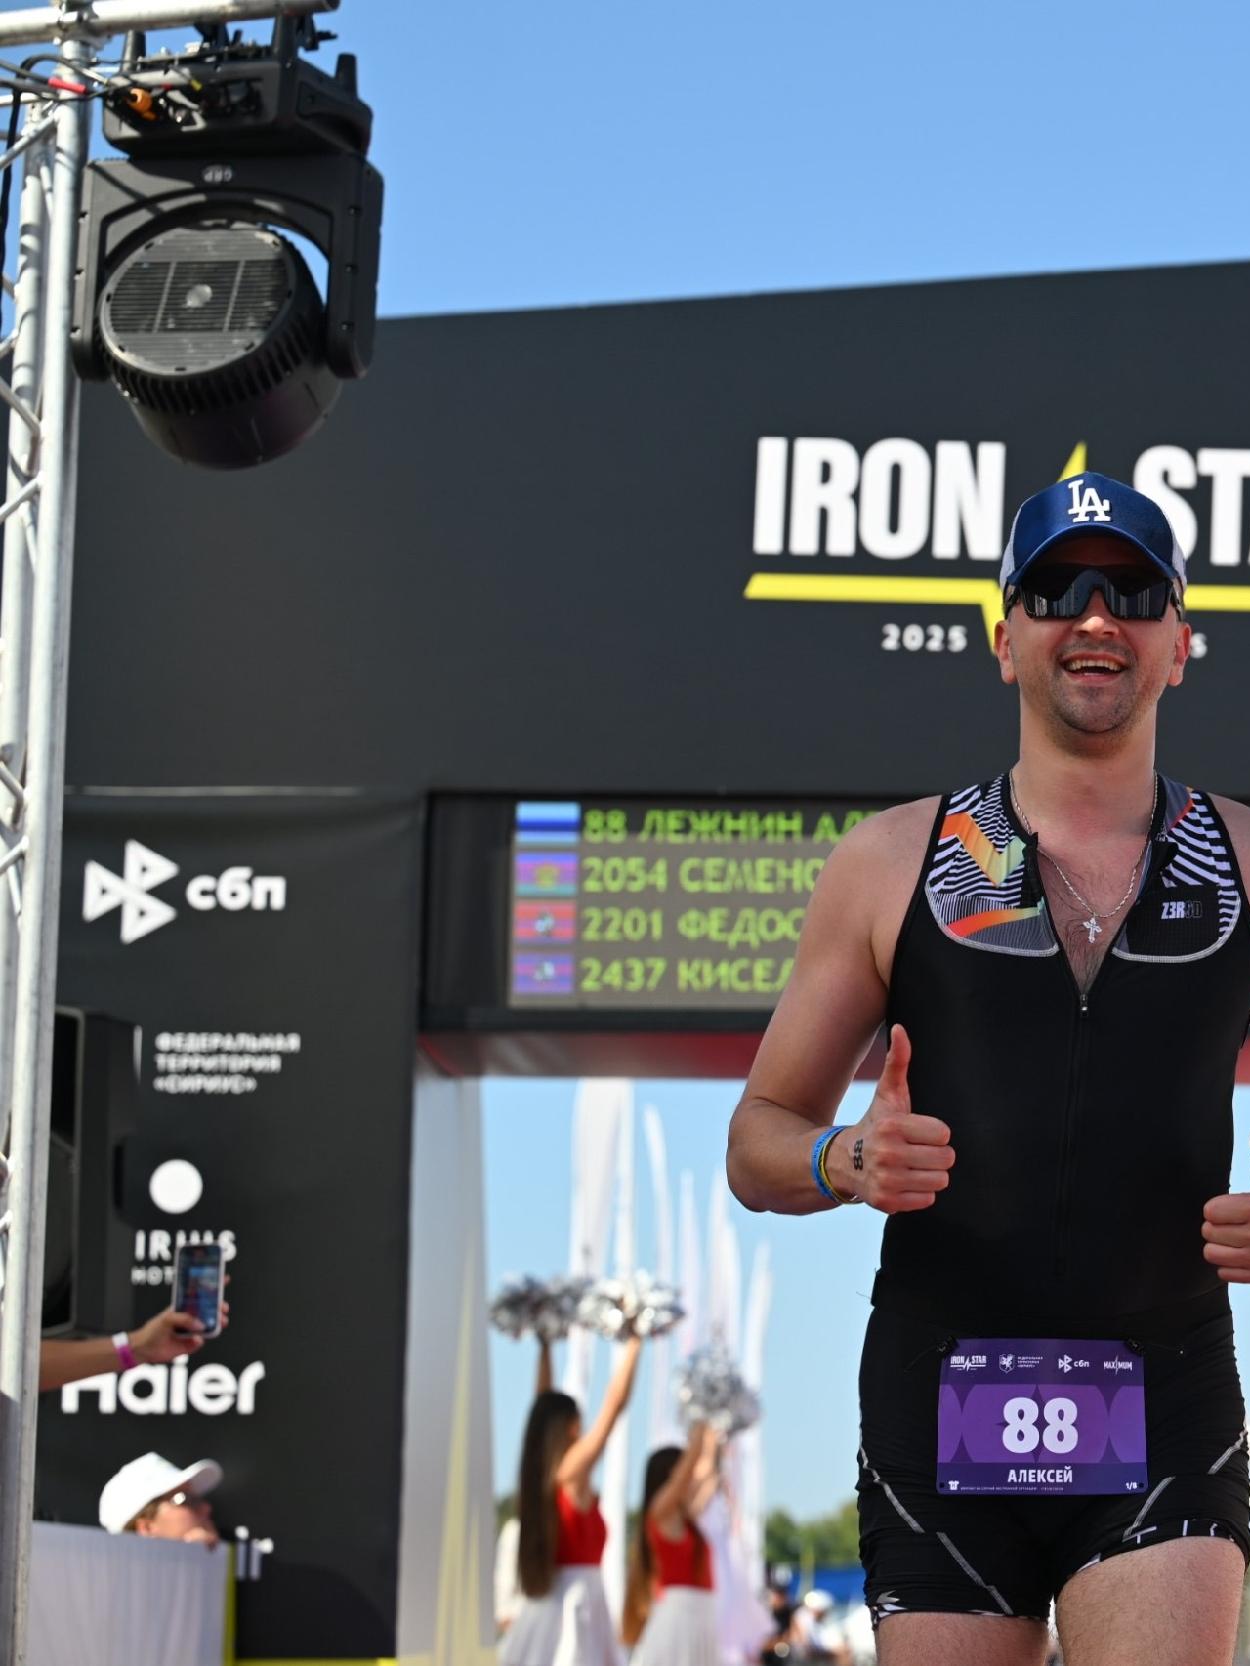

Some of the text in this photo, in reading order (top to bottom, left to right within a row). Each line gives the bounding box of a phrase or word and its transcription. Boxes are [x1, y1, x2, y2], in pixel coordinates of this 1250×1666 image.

[753, 436, 1006, 560] IRON
[1067, 478, 1112, 523] LA
[881, 623, 968, 653] 2025
[583, 809, 627, 843] 88
[637, 809, 803, 844] ЛЕЖНИН
[186, 866, 287, 911] сбп
[582, 856, 667, 893] 2054
[679, 856, 826, 893] СЕМЕНО
[582, 907, 663, 942] 2201
[678, 907, 807, 950] ФЕДОС
[580, 957, 667, 992] 2437
[677, 958, 795, 993] КИСЕЛ
[853, 1139, 864, 1171] 88
[1002, 1397, 1079, 1454] 88
[1007, 1466, 1073, 1483] АЛЕКСЕЙ
